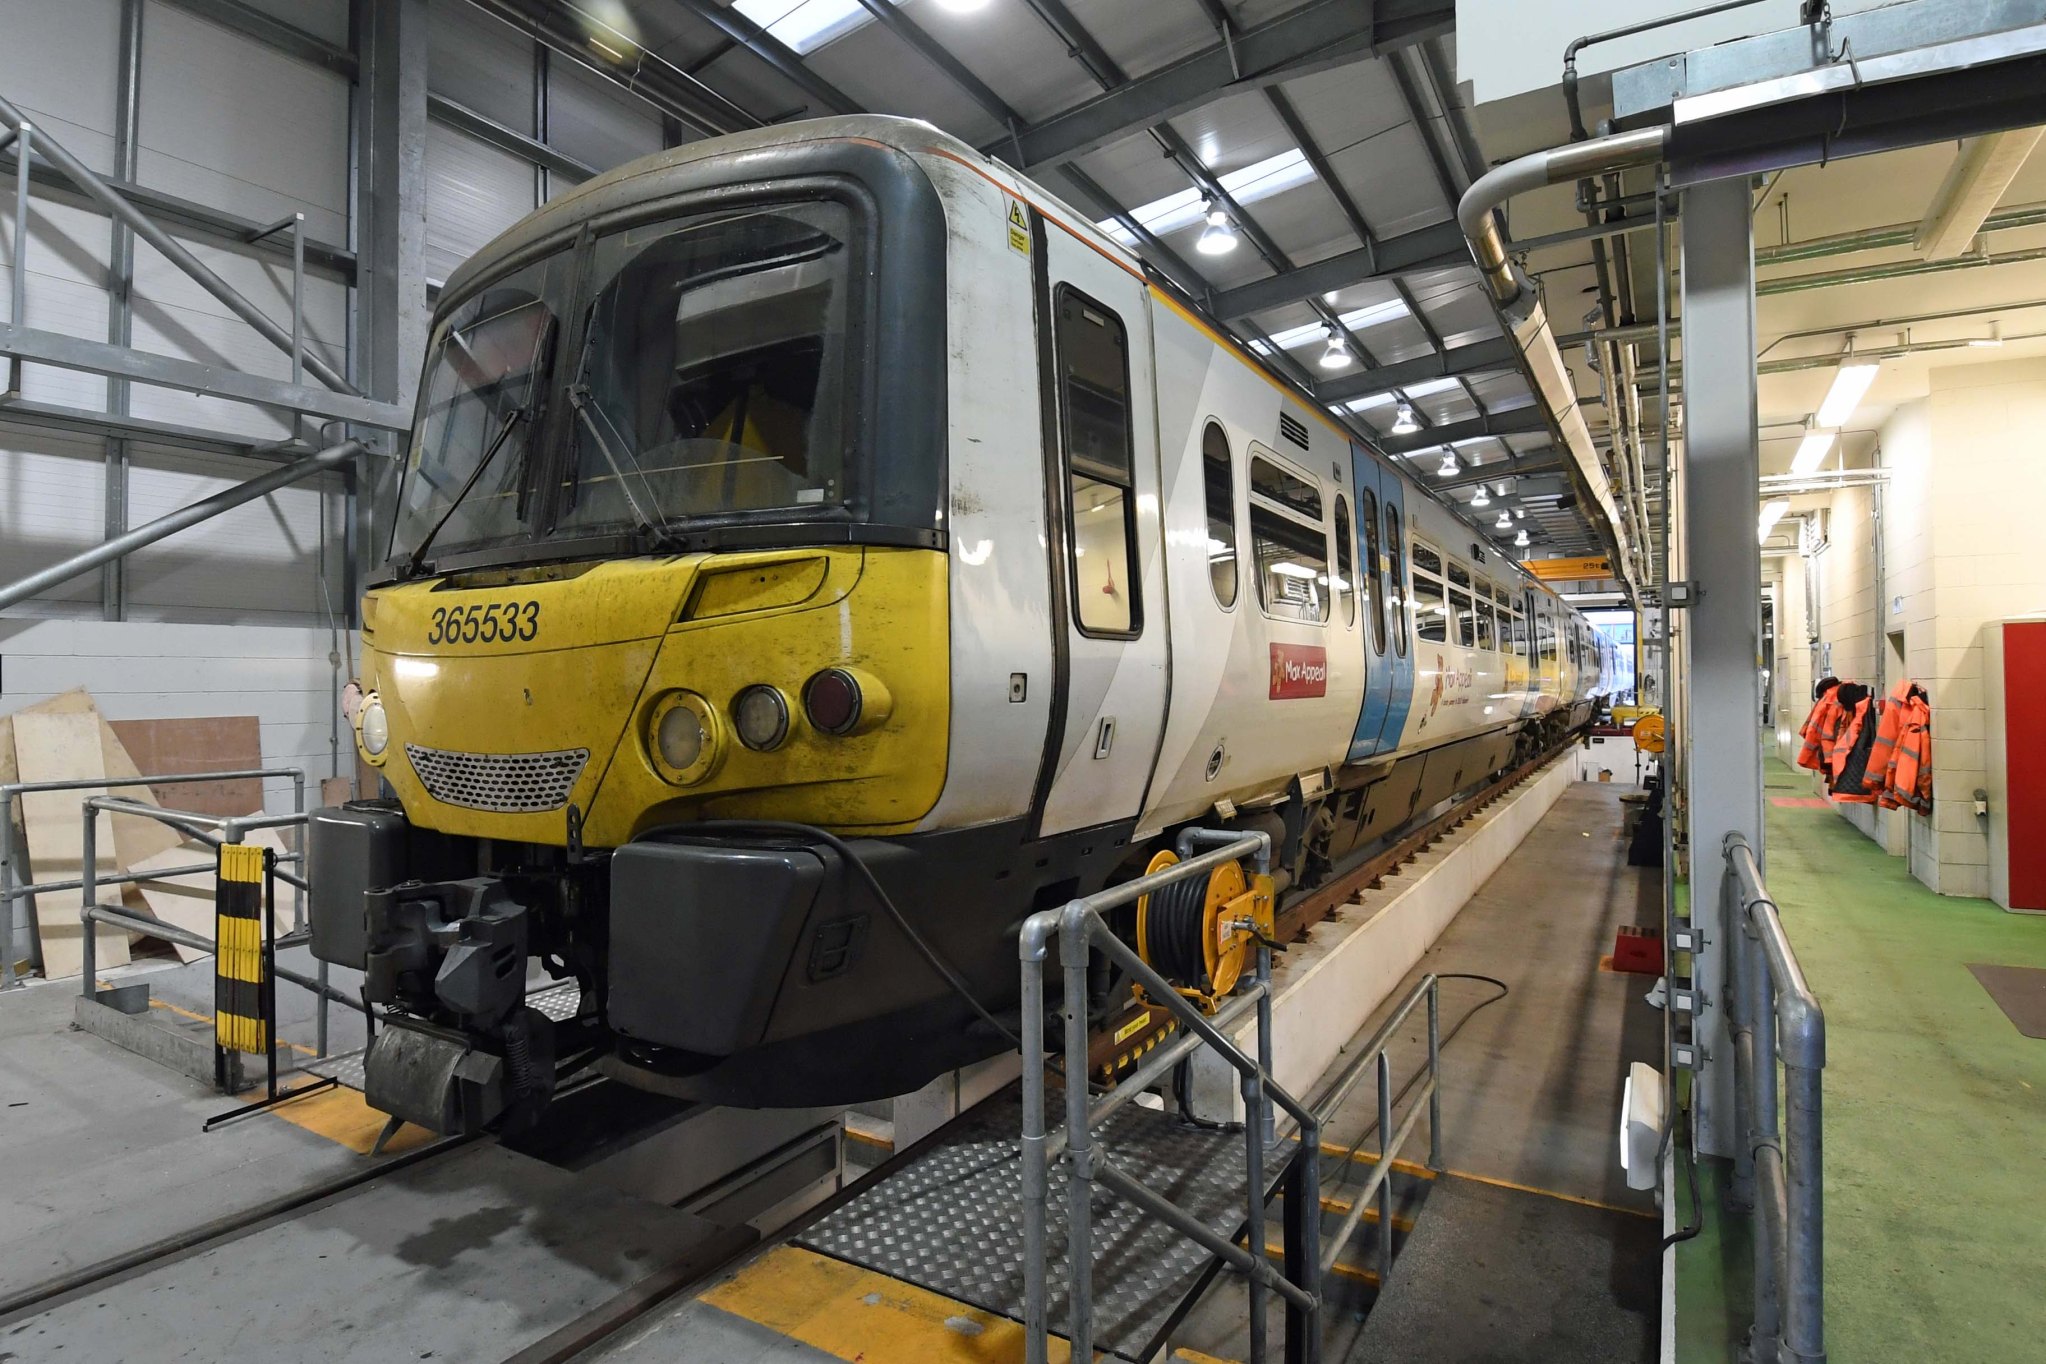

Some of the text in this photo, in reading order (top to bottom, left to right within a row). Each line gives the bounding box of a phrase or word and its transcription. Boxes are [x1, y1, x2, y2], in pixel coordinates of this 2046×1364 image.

[428, 600, 540, 645] 365533
[1285, 659, 1326, 685] Max Appeal
